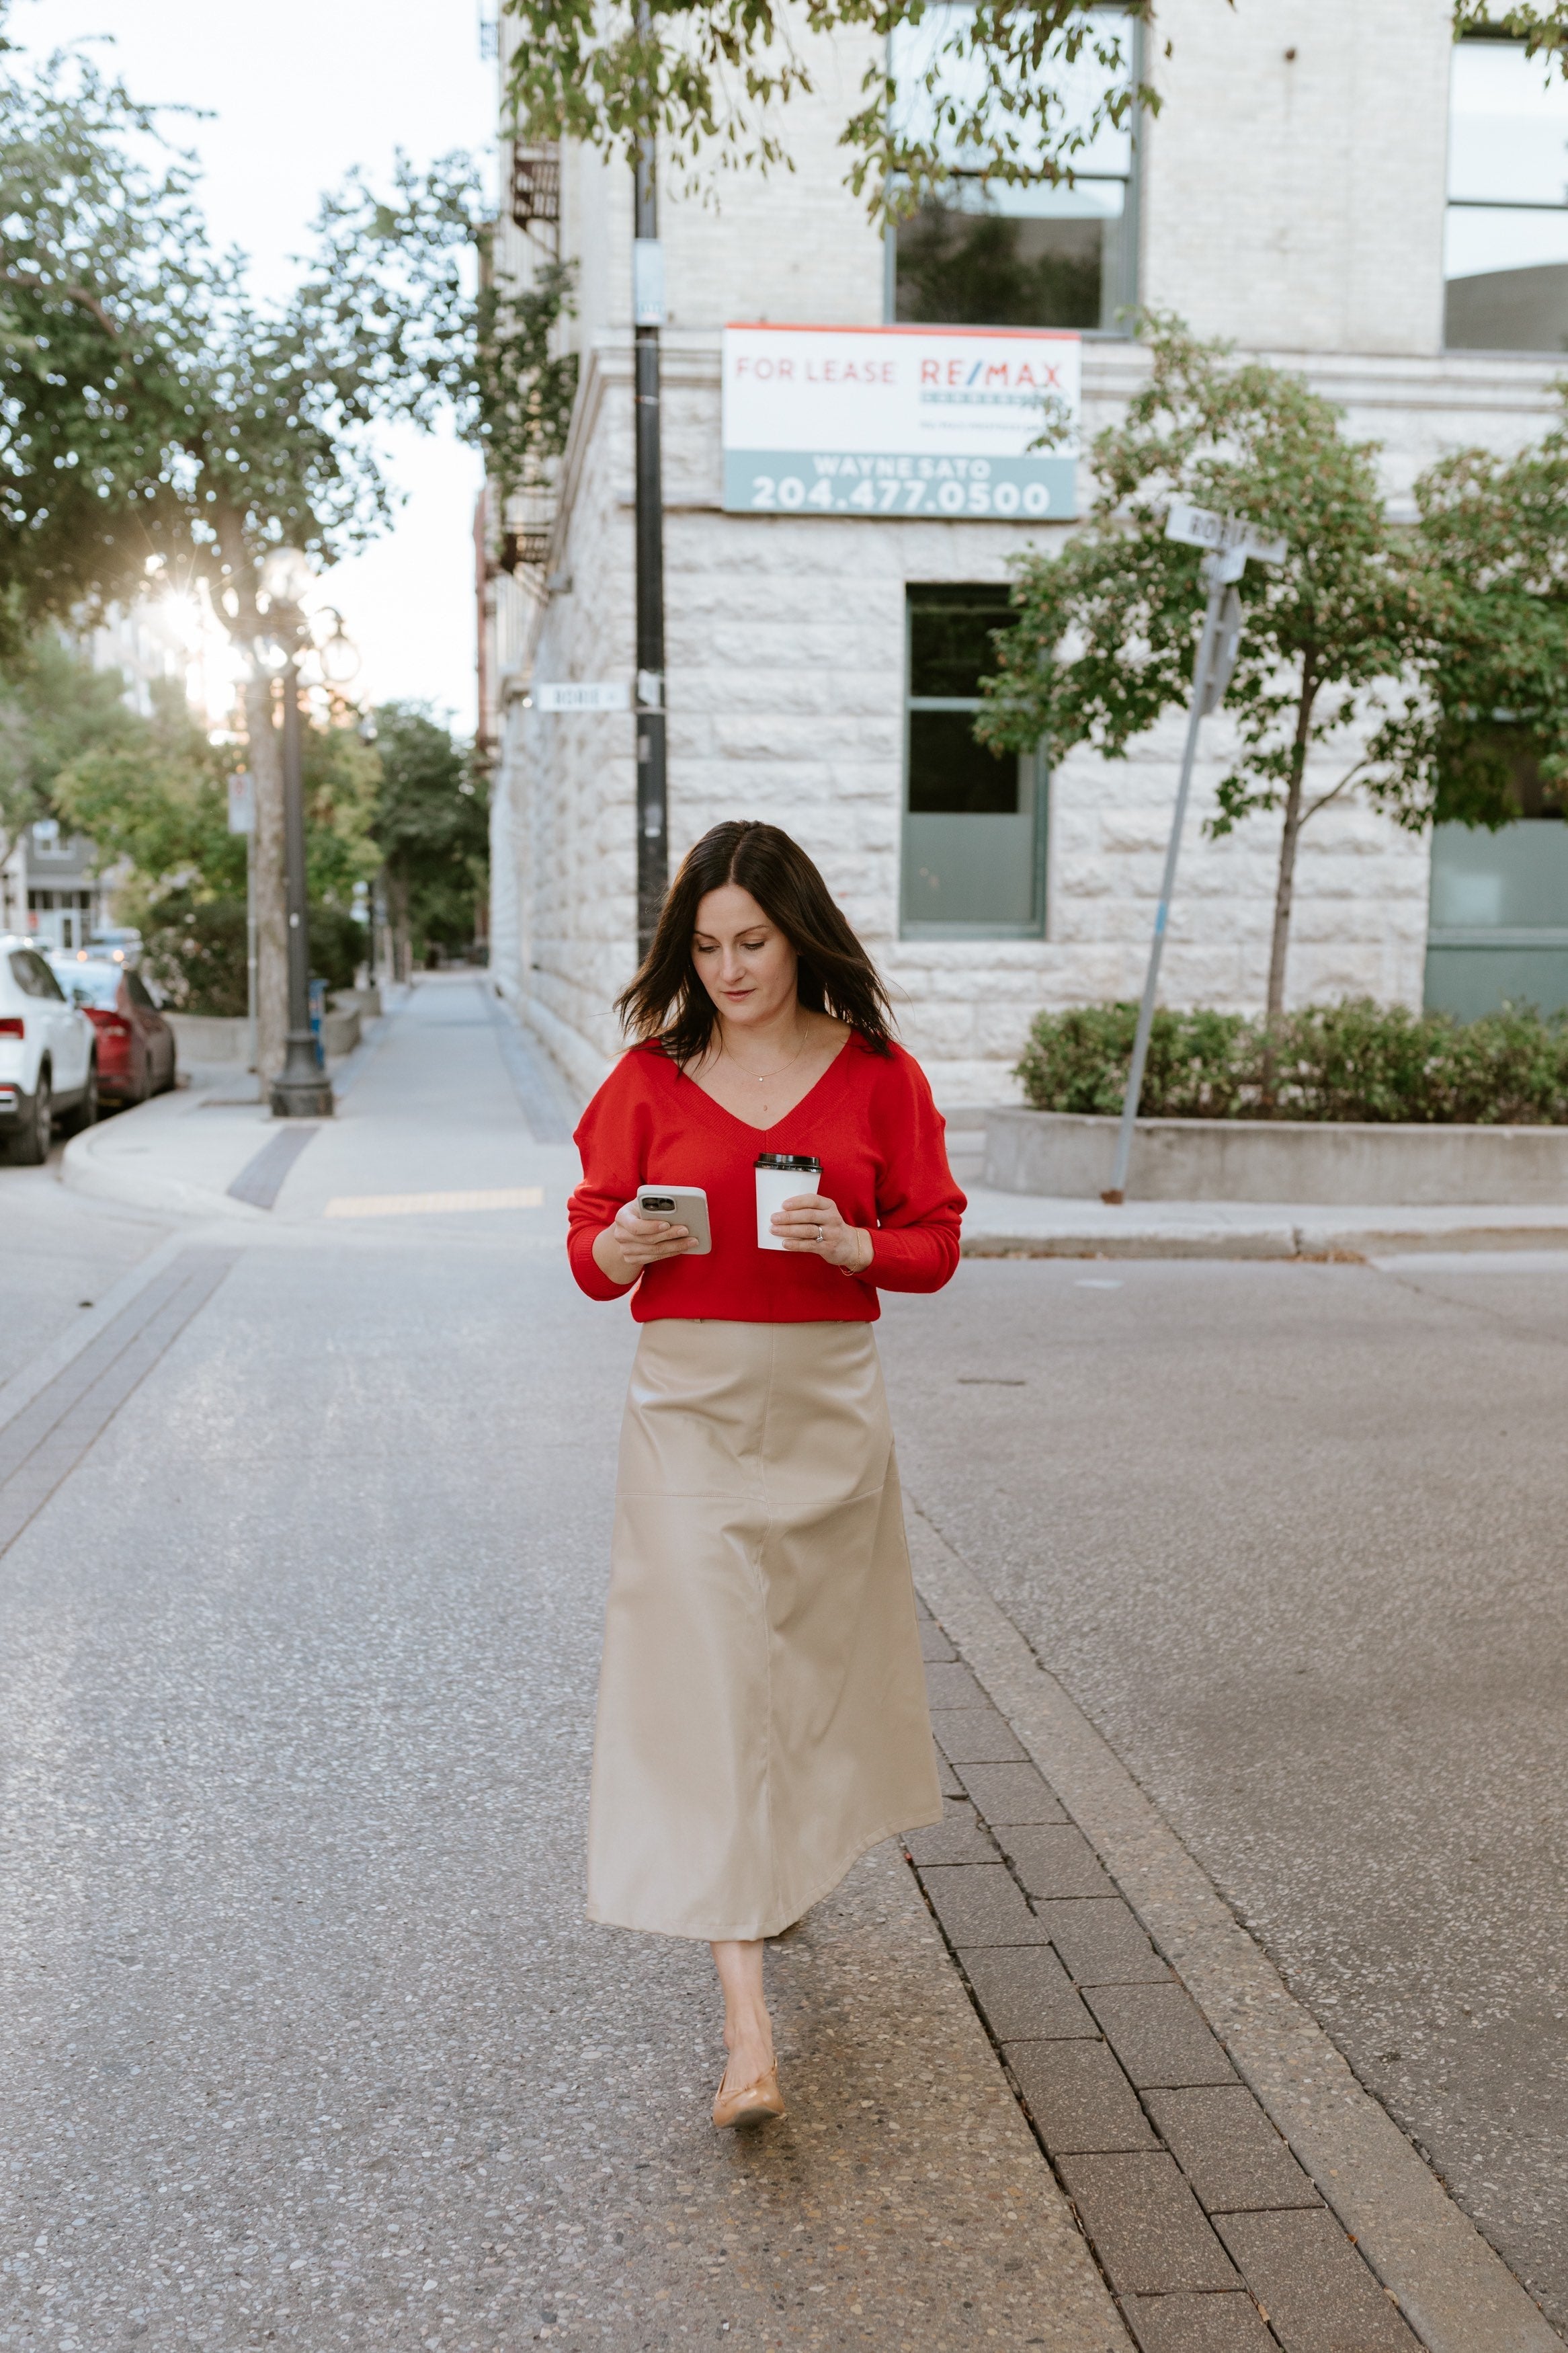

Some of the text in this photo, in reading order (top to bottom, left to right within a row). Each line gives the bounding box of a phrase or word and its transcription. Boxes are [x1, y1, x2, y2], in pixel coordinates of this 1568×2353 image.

[737, 358, 896, 383] FOR LEASE
[920, 359, 1061, 387] RE/MAX
[812, 455, 992, 479] WAYNE SATO
[751, 476, 1050, 515] 204.477.0500
